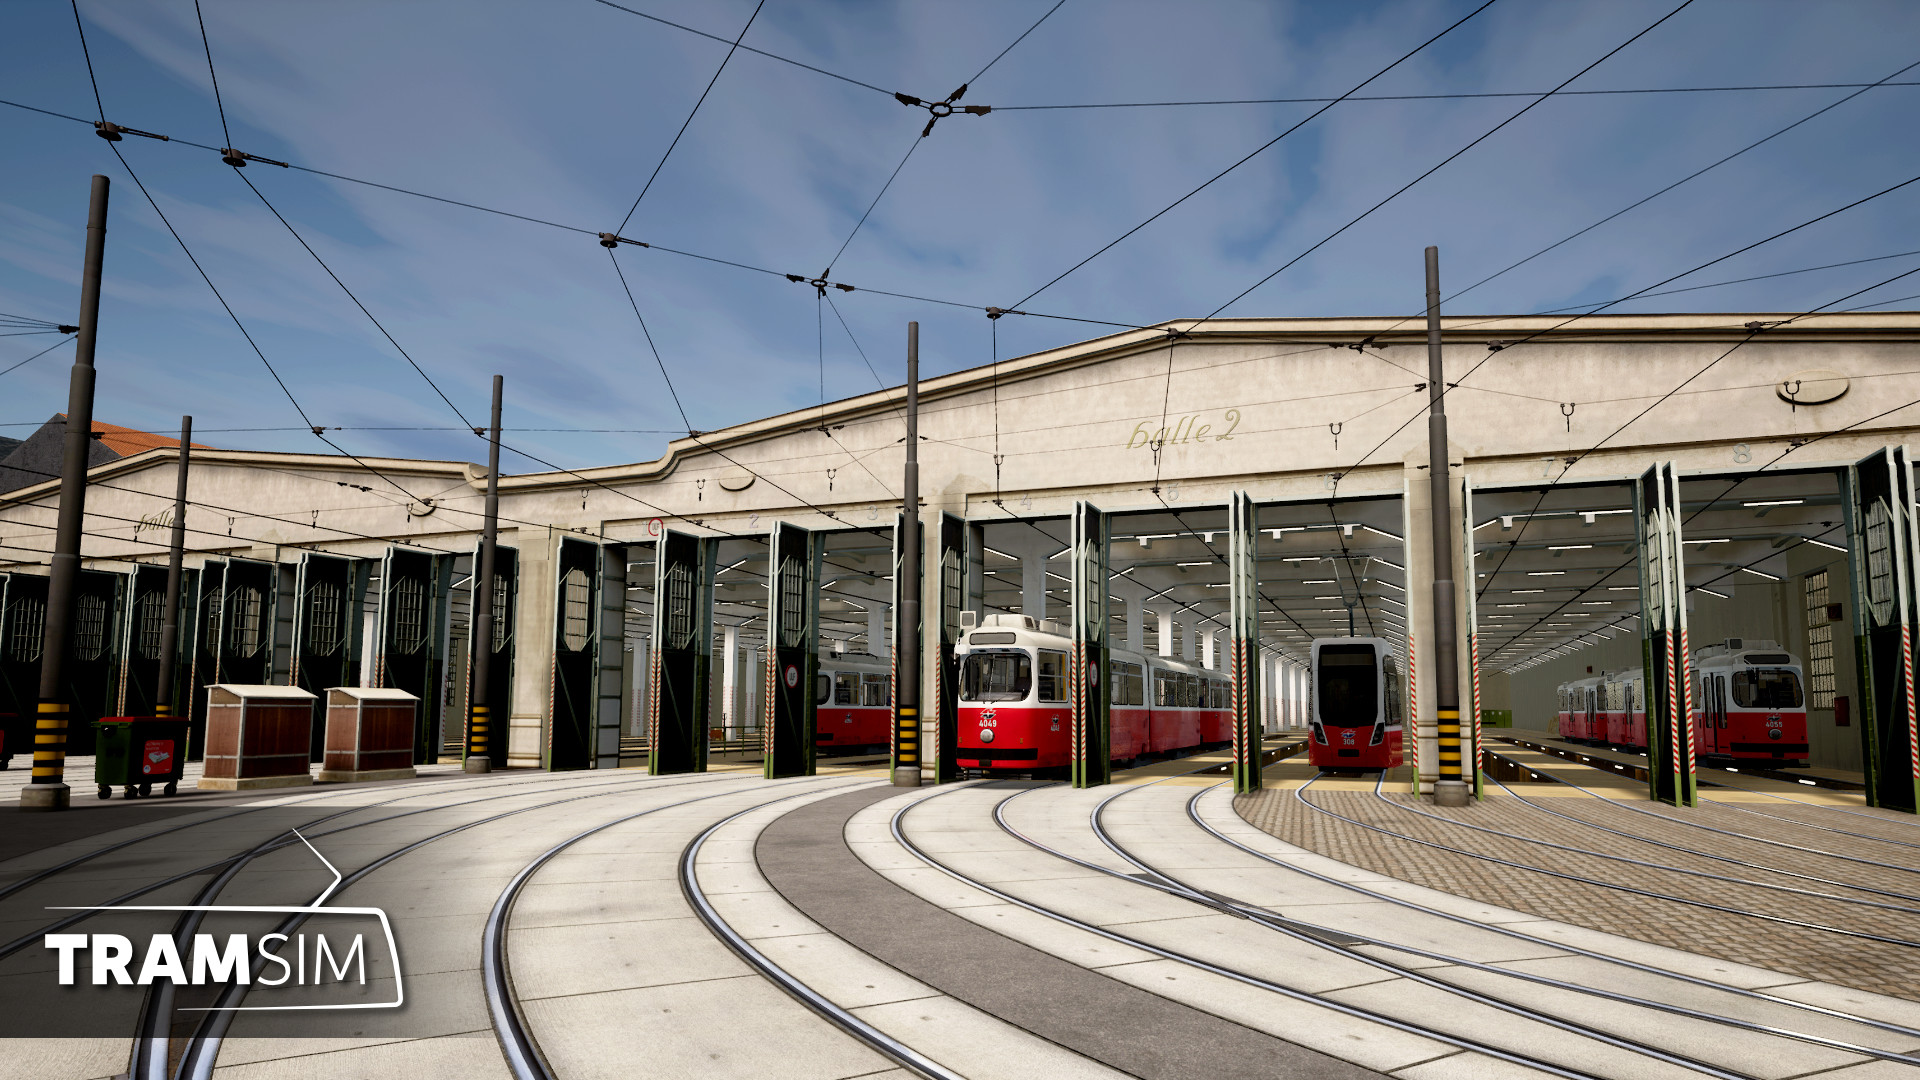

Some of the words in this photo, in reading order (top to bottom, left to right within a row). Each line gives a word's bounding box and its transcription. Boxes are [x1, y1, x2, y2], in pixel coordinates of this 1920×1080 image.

[1215, 409, 1241, 441] 2
[1733, 443, 1752, 463] 8
[1541, 456, 1555, 477] 7
[1167, 483, 1179, 501] 5
[1020, 493, 1032, 510] 4
[750, 512, 759, 528] 2
[867, 505, 878, 520] 3
[979, 719, 997, 728] 4049
[1343, 738, 1355, 746] 308
